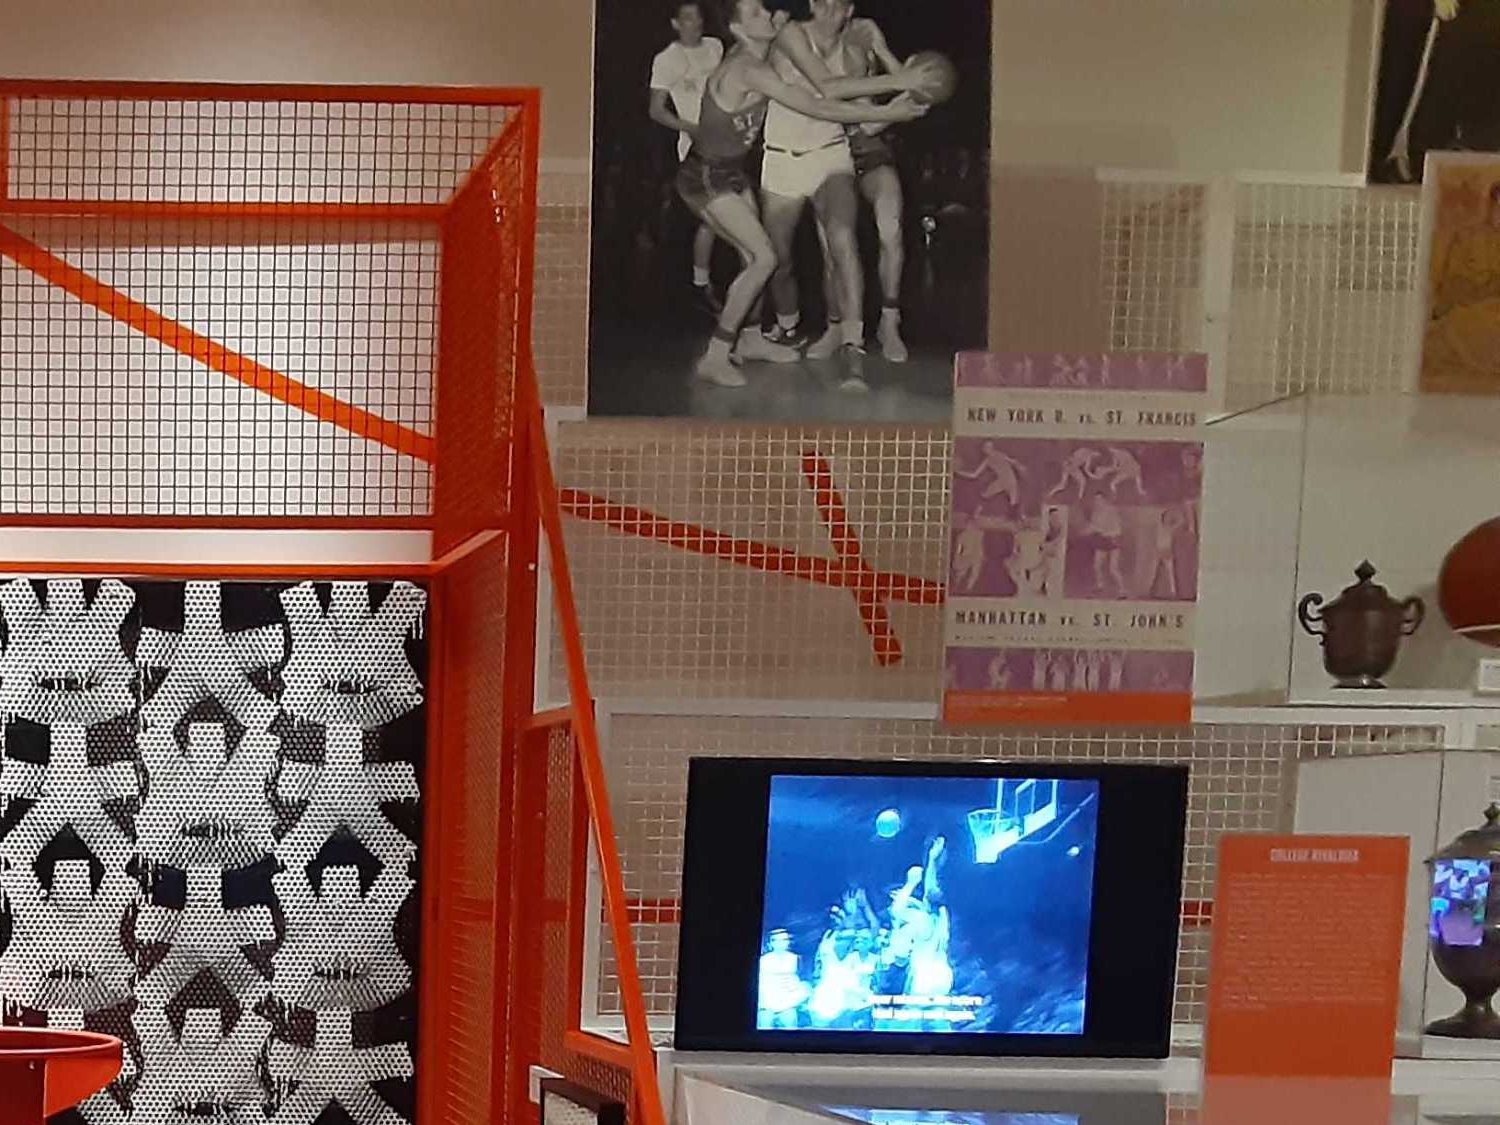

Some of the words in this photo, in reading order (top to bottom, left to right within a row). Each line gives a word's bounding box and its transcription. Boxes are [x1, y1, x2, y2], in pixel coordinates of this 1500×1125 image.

[967, 407, 997, 422] NEW
[1007, 407, 1045, 424] YORK
[955, 610, 1047, 625] MANHATTAN
